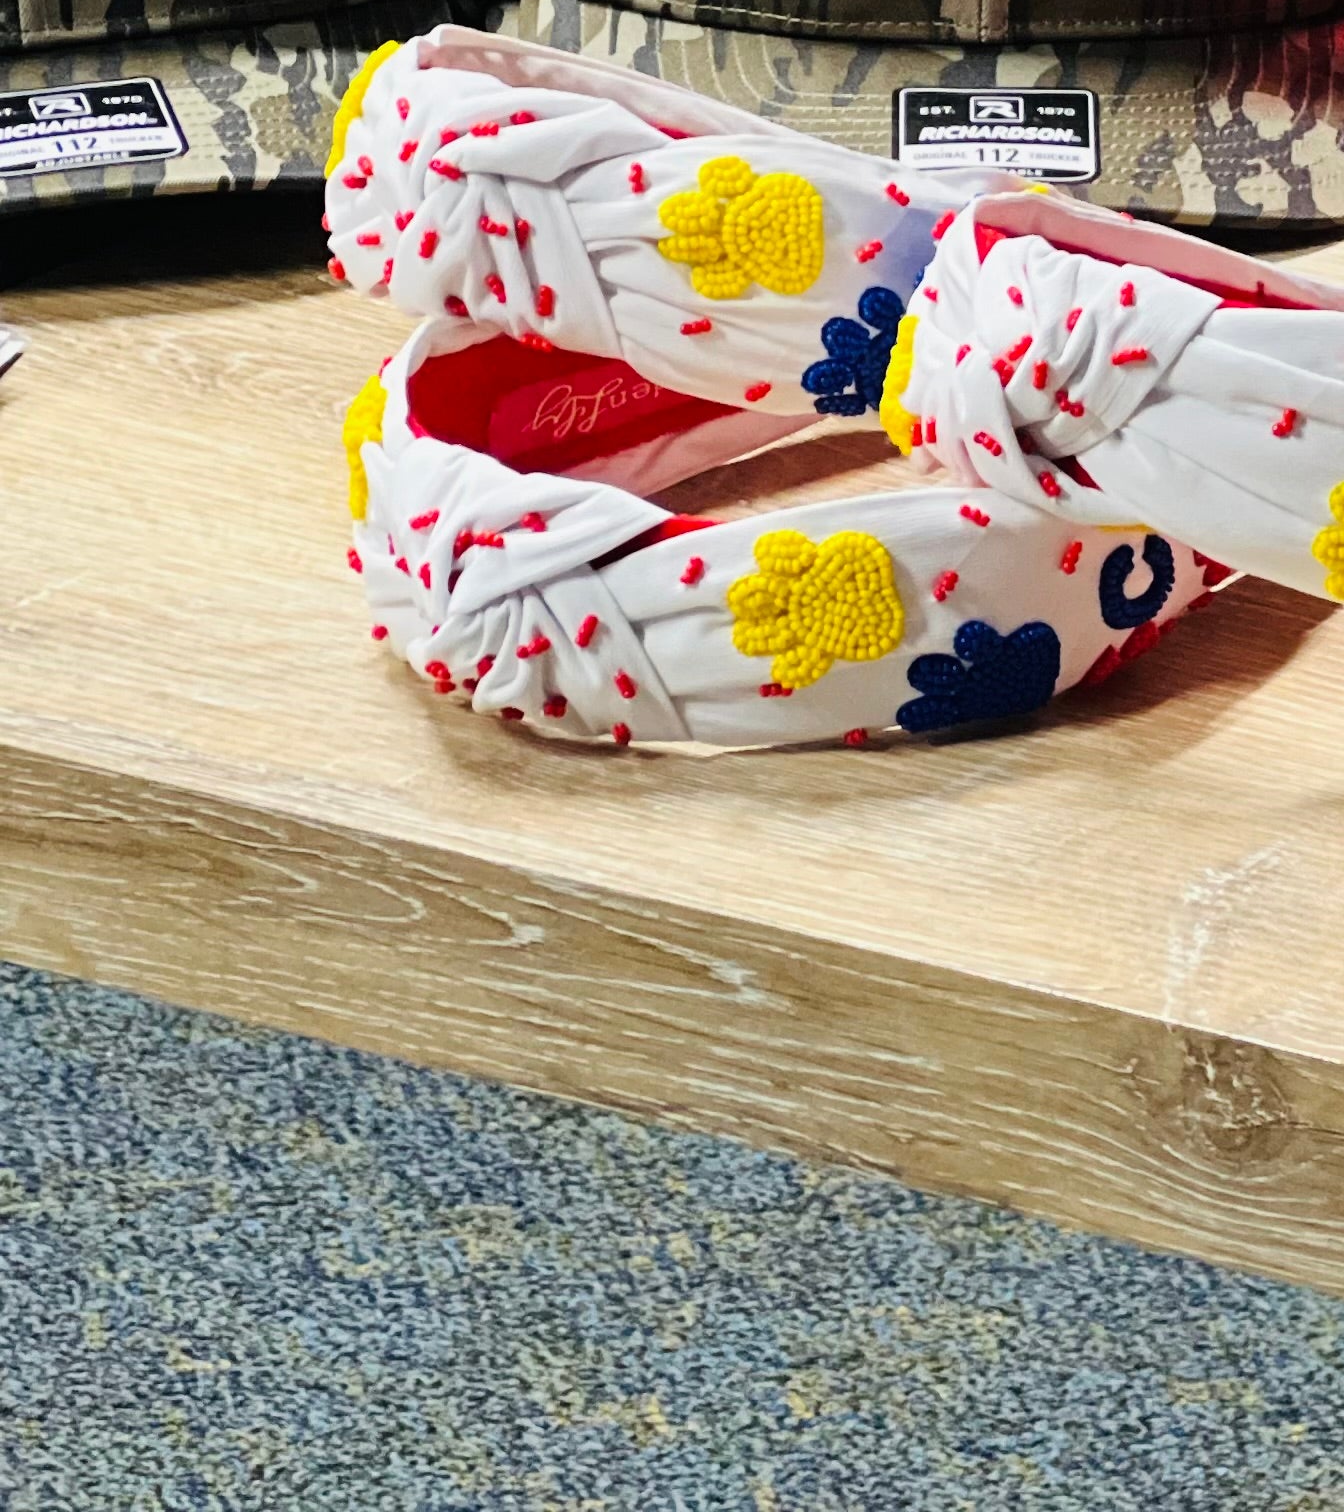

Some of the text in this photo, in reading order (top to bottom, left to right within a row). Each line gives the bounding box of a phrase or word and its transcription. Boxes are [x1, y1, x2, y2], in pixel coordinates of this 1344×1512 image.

[918, 125, 1073, 142] RICHARDSON
[52, 136, 98, 153] 112
[975, 147, 1020, 163] 112
